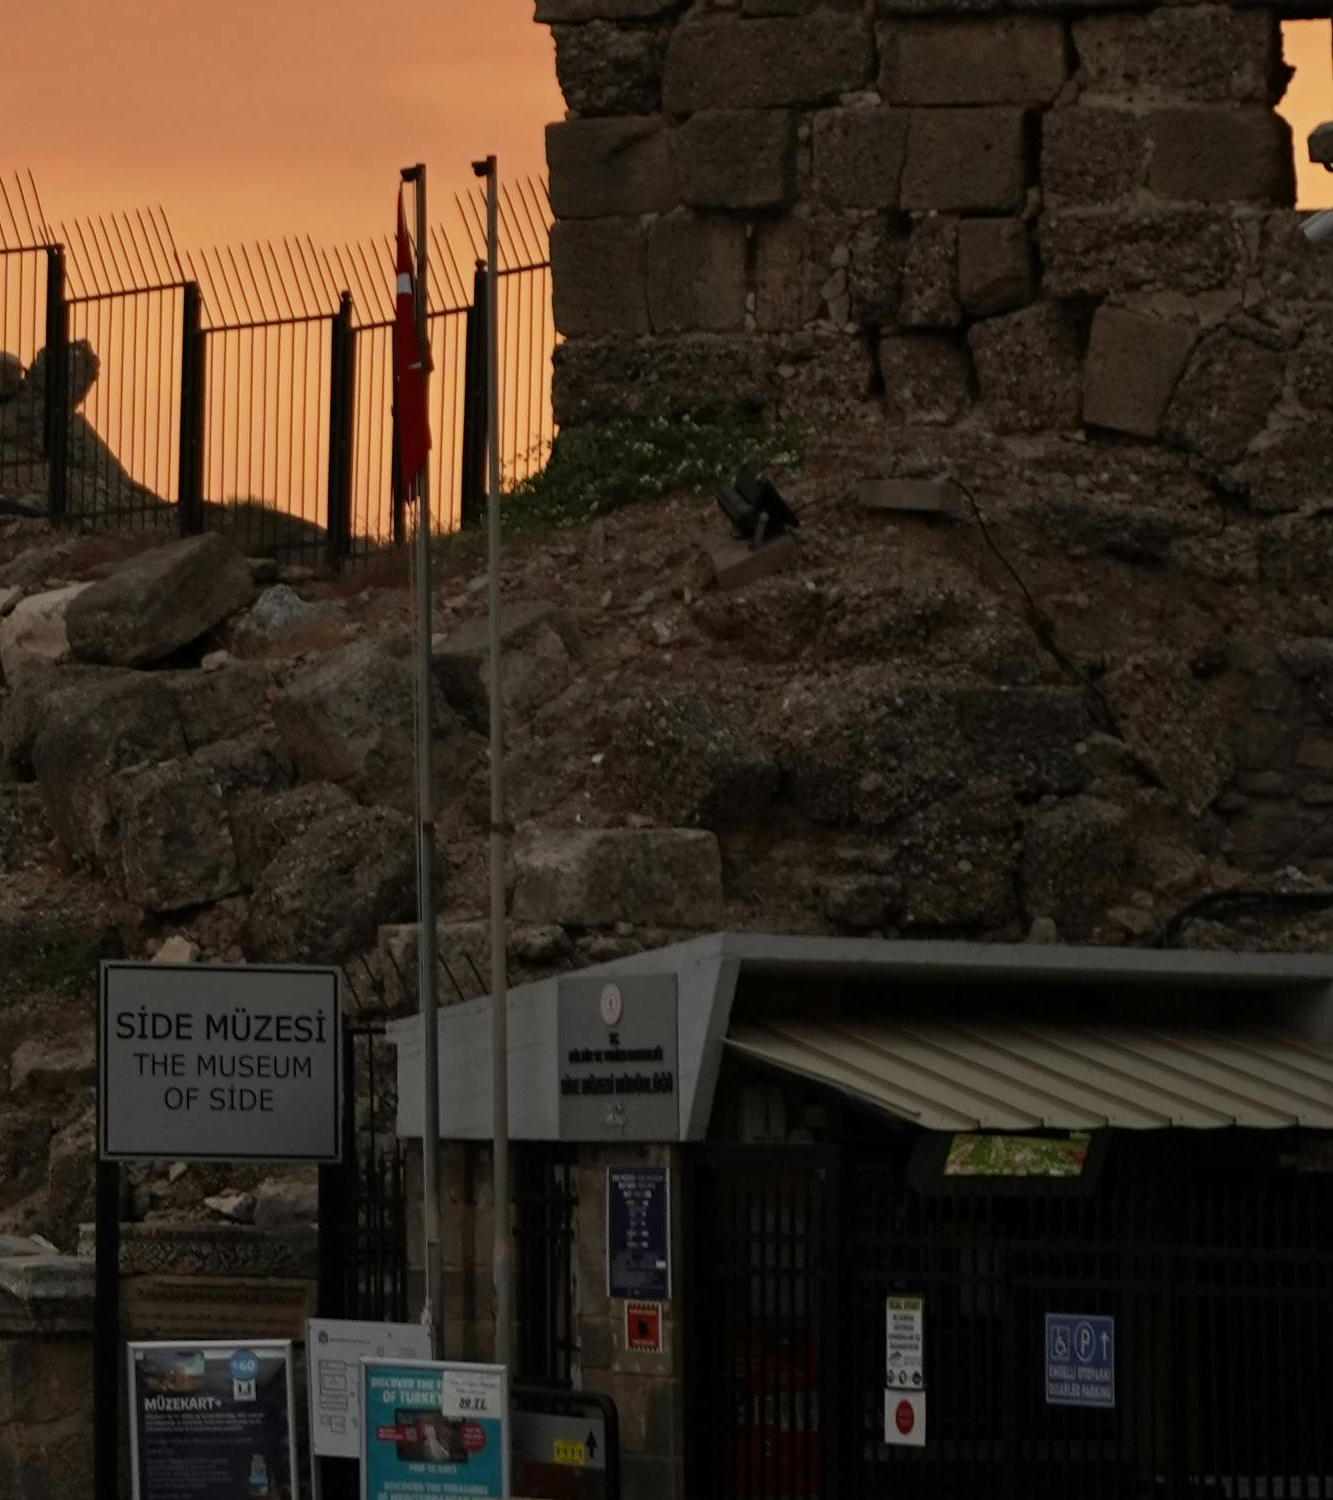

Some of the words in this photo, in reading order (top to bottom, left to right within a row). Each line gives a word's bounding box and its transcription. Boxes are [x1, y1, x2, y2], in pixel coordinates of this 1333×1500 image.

[116, 1005, 192, 1040] SİDE
[206, 1008, 326, 1043] MÜZESİ
[133, 1052, 186, 1077] THE
[197, 1054, 312, 1079] MUSEUM
[164, 1087, 199, 1111] OF
[210, 1084, 274, 1112] SİDE
[1081, 1328, 1090, 1355] P
[144, 1394, 223, 1411] MÜZEKART+
[383, 1390, 397, 1405] OF
